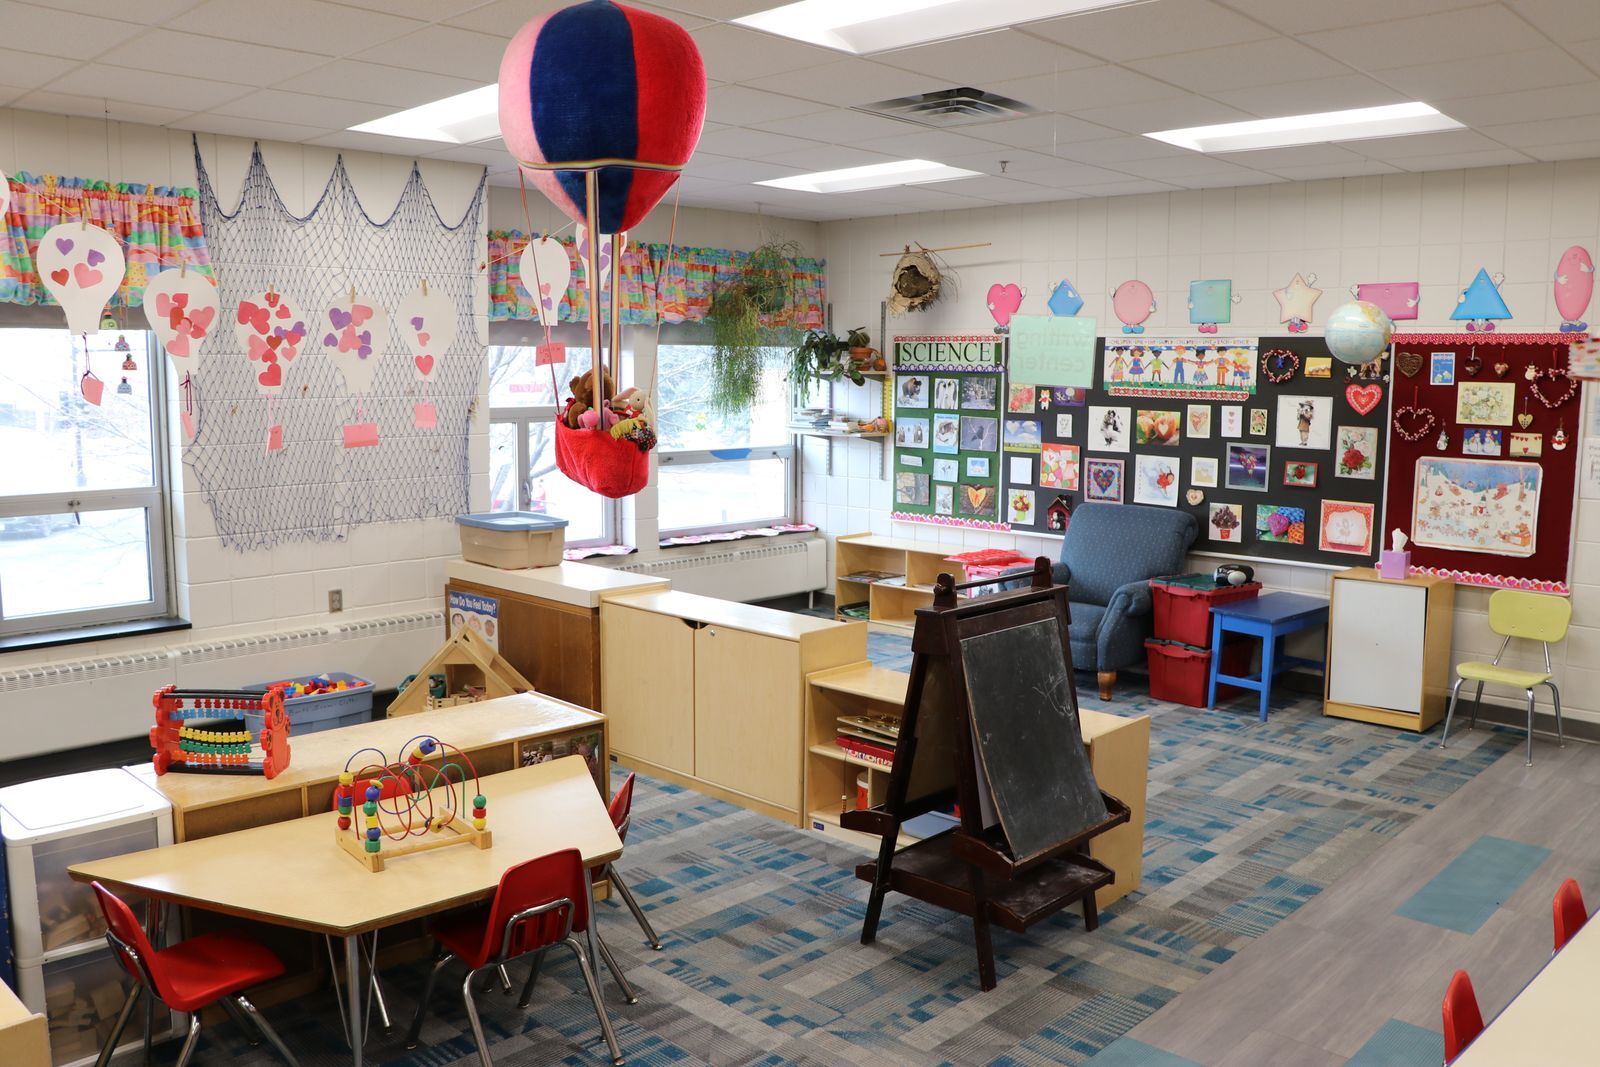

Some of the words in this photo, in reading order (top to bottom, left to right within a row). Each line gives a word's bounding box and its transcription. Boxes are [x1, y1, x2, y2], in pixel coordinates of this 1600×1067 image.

[902, 342, 991, 362] SCIENCE
[449, 594, 459, 605] How
[465, 597, 473, 608] You
[473, 599, 482, 610] Feel
[482, 600, 497, 615] Today?
